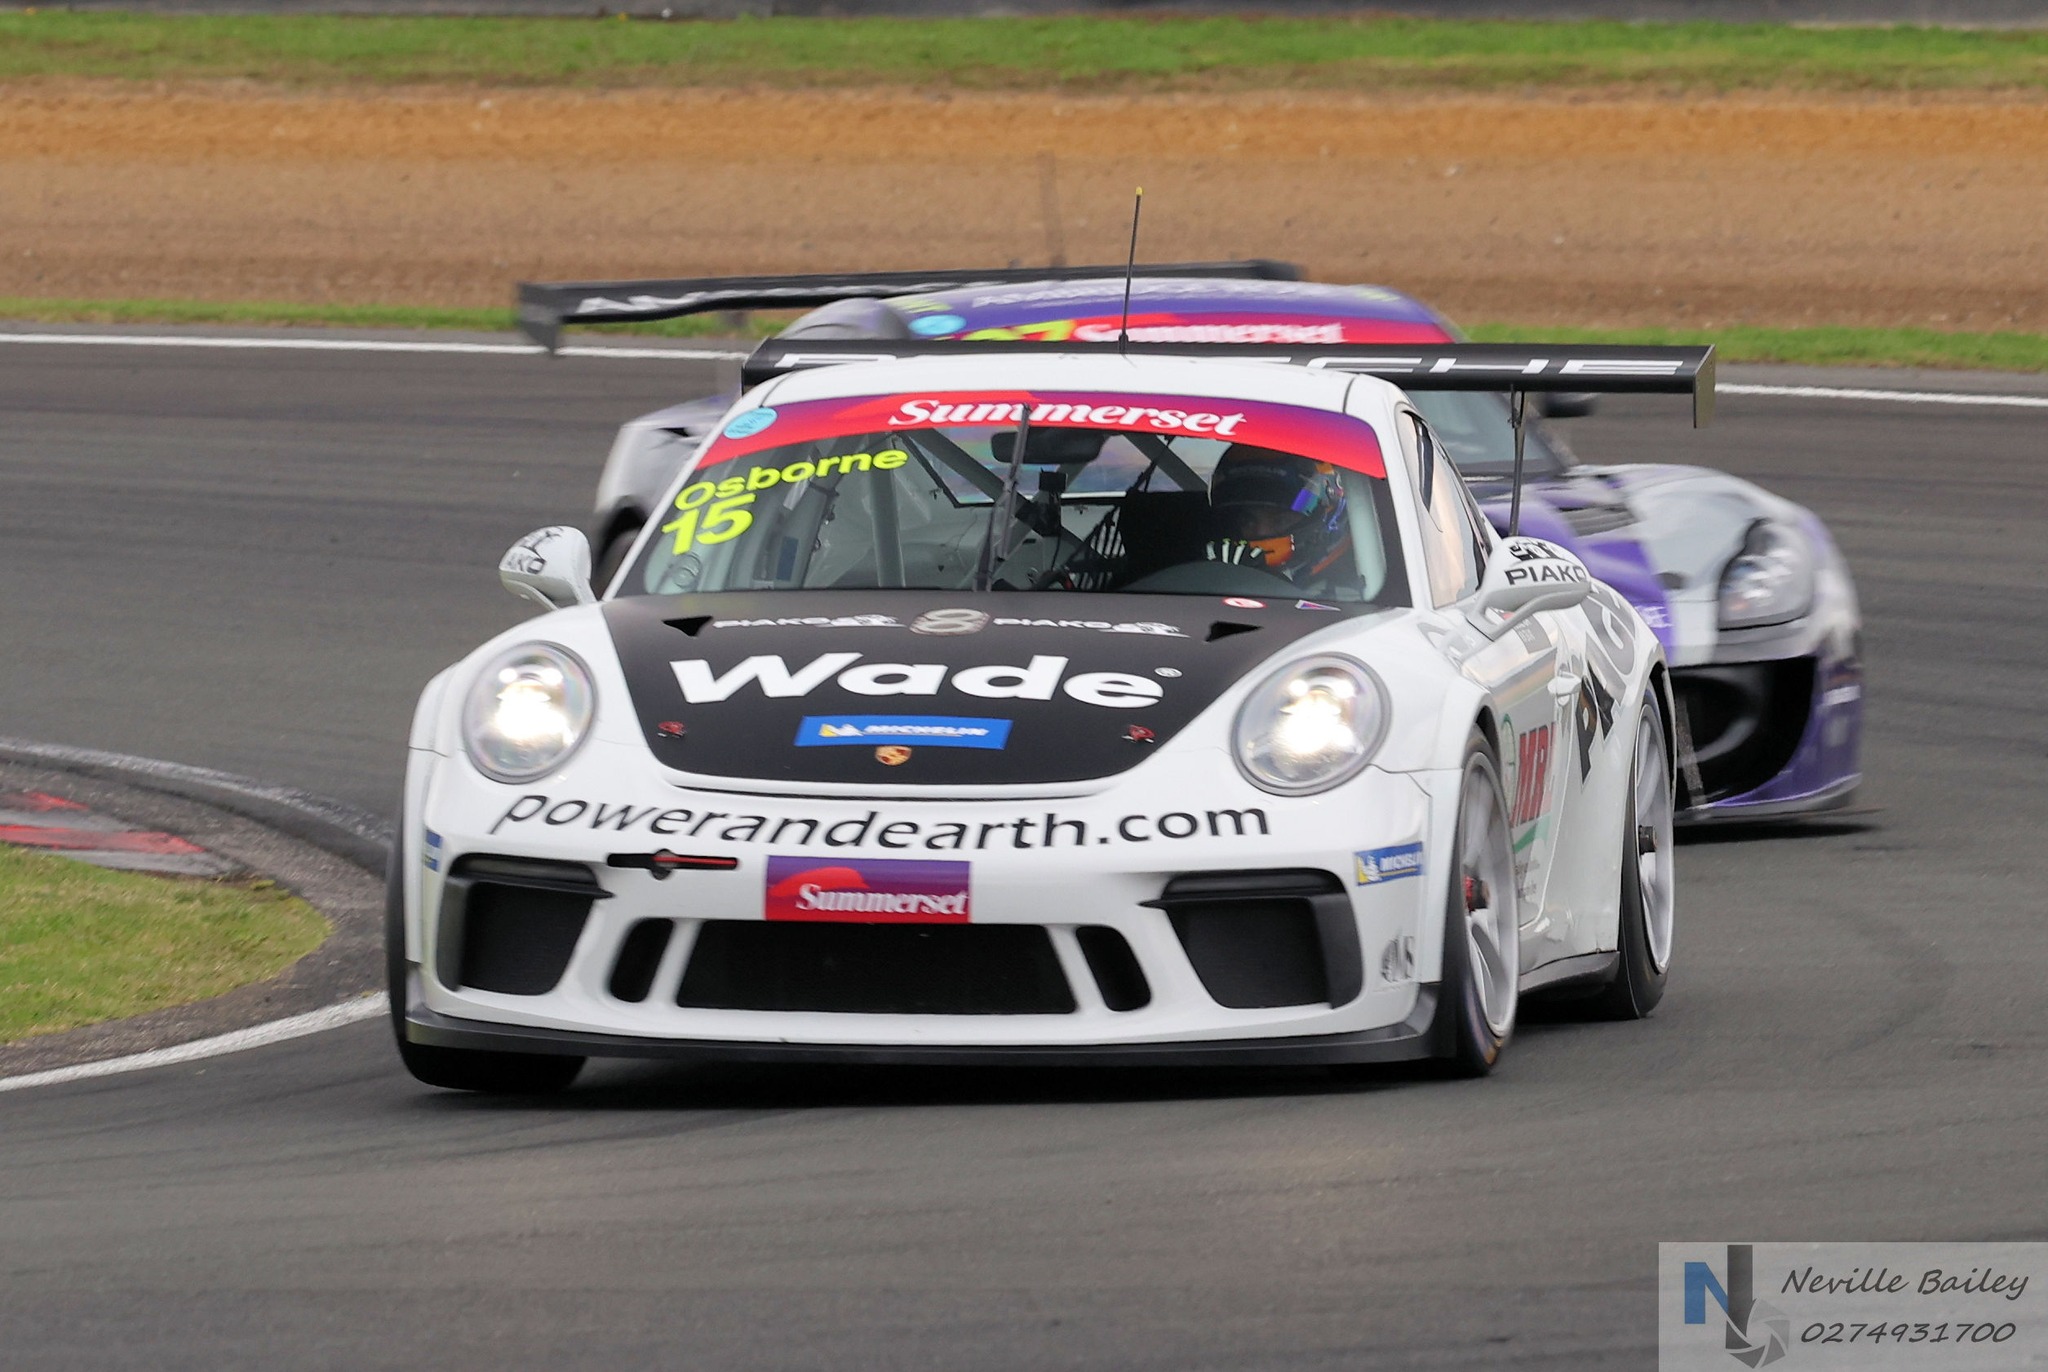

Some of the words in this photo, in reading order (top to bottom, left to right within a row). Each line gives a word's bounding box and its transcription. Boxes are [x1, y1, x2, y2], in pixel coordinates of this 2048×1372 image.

[888, 399, 1247, 436] Summerset
[674, 449, 908, 511] Osborne
[662, 493, 756, 556] 15
[669, 652, 1164, 708] Wade
[489, 794, 1271, 850] powerandearth.com
[795, 883, 970, 914] Summerset
